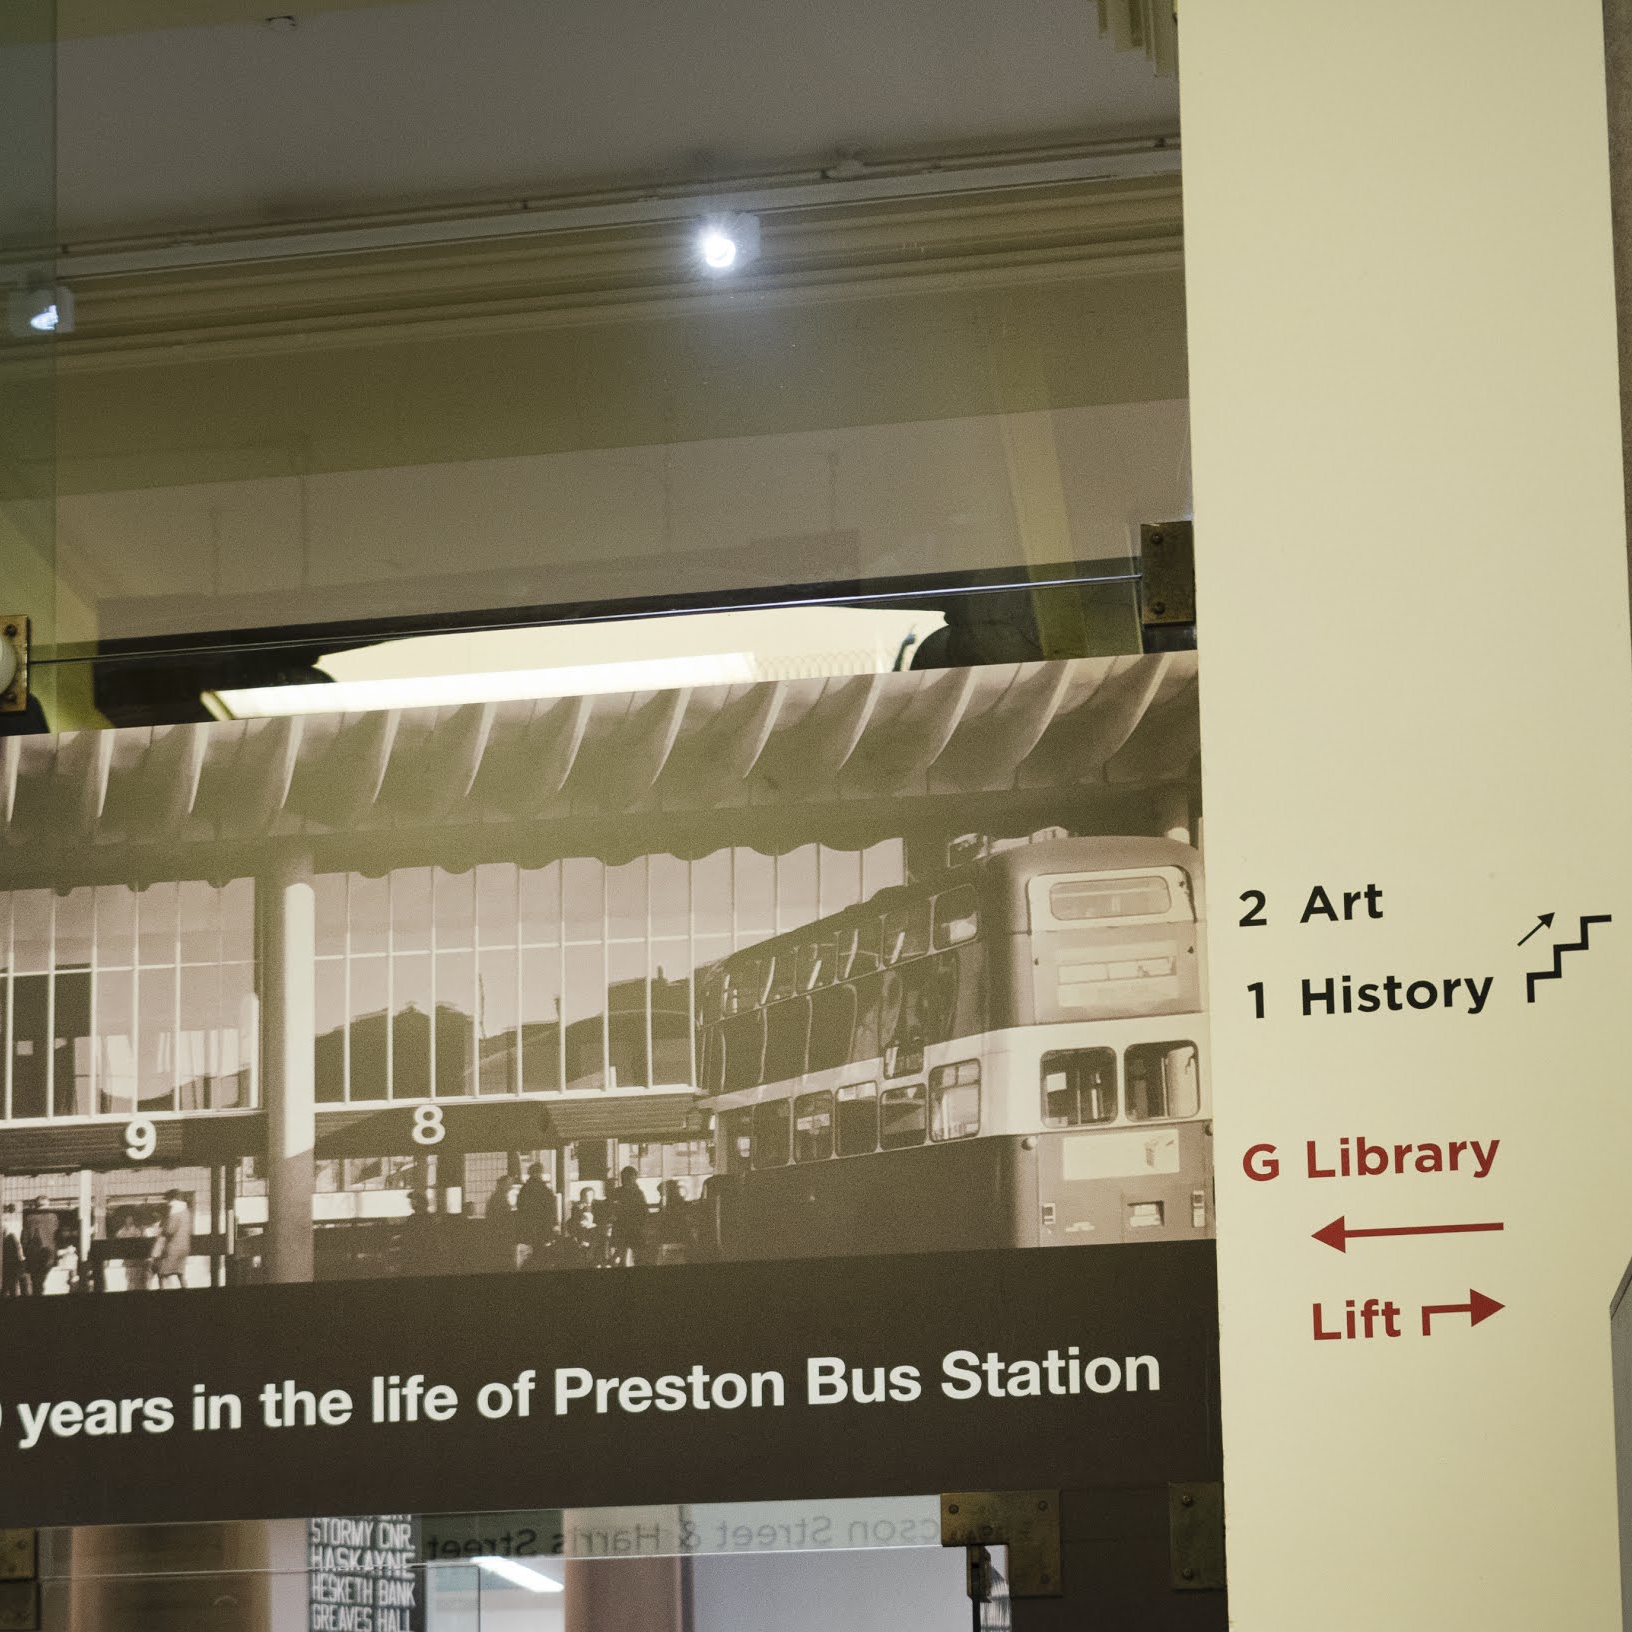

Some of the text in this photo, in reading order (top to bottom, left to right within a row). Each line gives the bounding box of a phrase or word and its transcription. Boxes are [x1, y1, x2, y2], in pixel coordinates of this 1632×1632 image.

[1238, 883, 1384, 927] 2 Art
[1247, 975, 1494, 1019] 1 History
[125, 1119, 157, 1160] 9
[412, 1105, 445, 1146] 8
[1242, 1136, 1501, 1182] G Library
[1312, 1299, 1402, 1341] Lift
[17, 1389, 175, 1449] years
[192, 1384, 242, 1432] in
[260, 1378, 353, 1428] the
[372, 1375, 458, 1424] life
[477, 1370, 535, 1419] of
[555, 1366, 785, 1416] Preston
[808, 1357, 922, 1407] Bus
[941, 1346, 1161, 1400] Station
[311, 1517, 415, 1550] STORMY CNR.
[311, 1545, 415, 1579] HASKAYNE
[311, 1573, 415, 1607] HESKETH BANK
[312, 1603, 373, 1632] GREAVES
